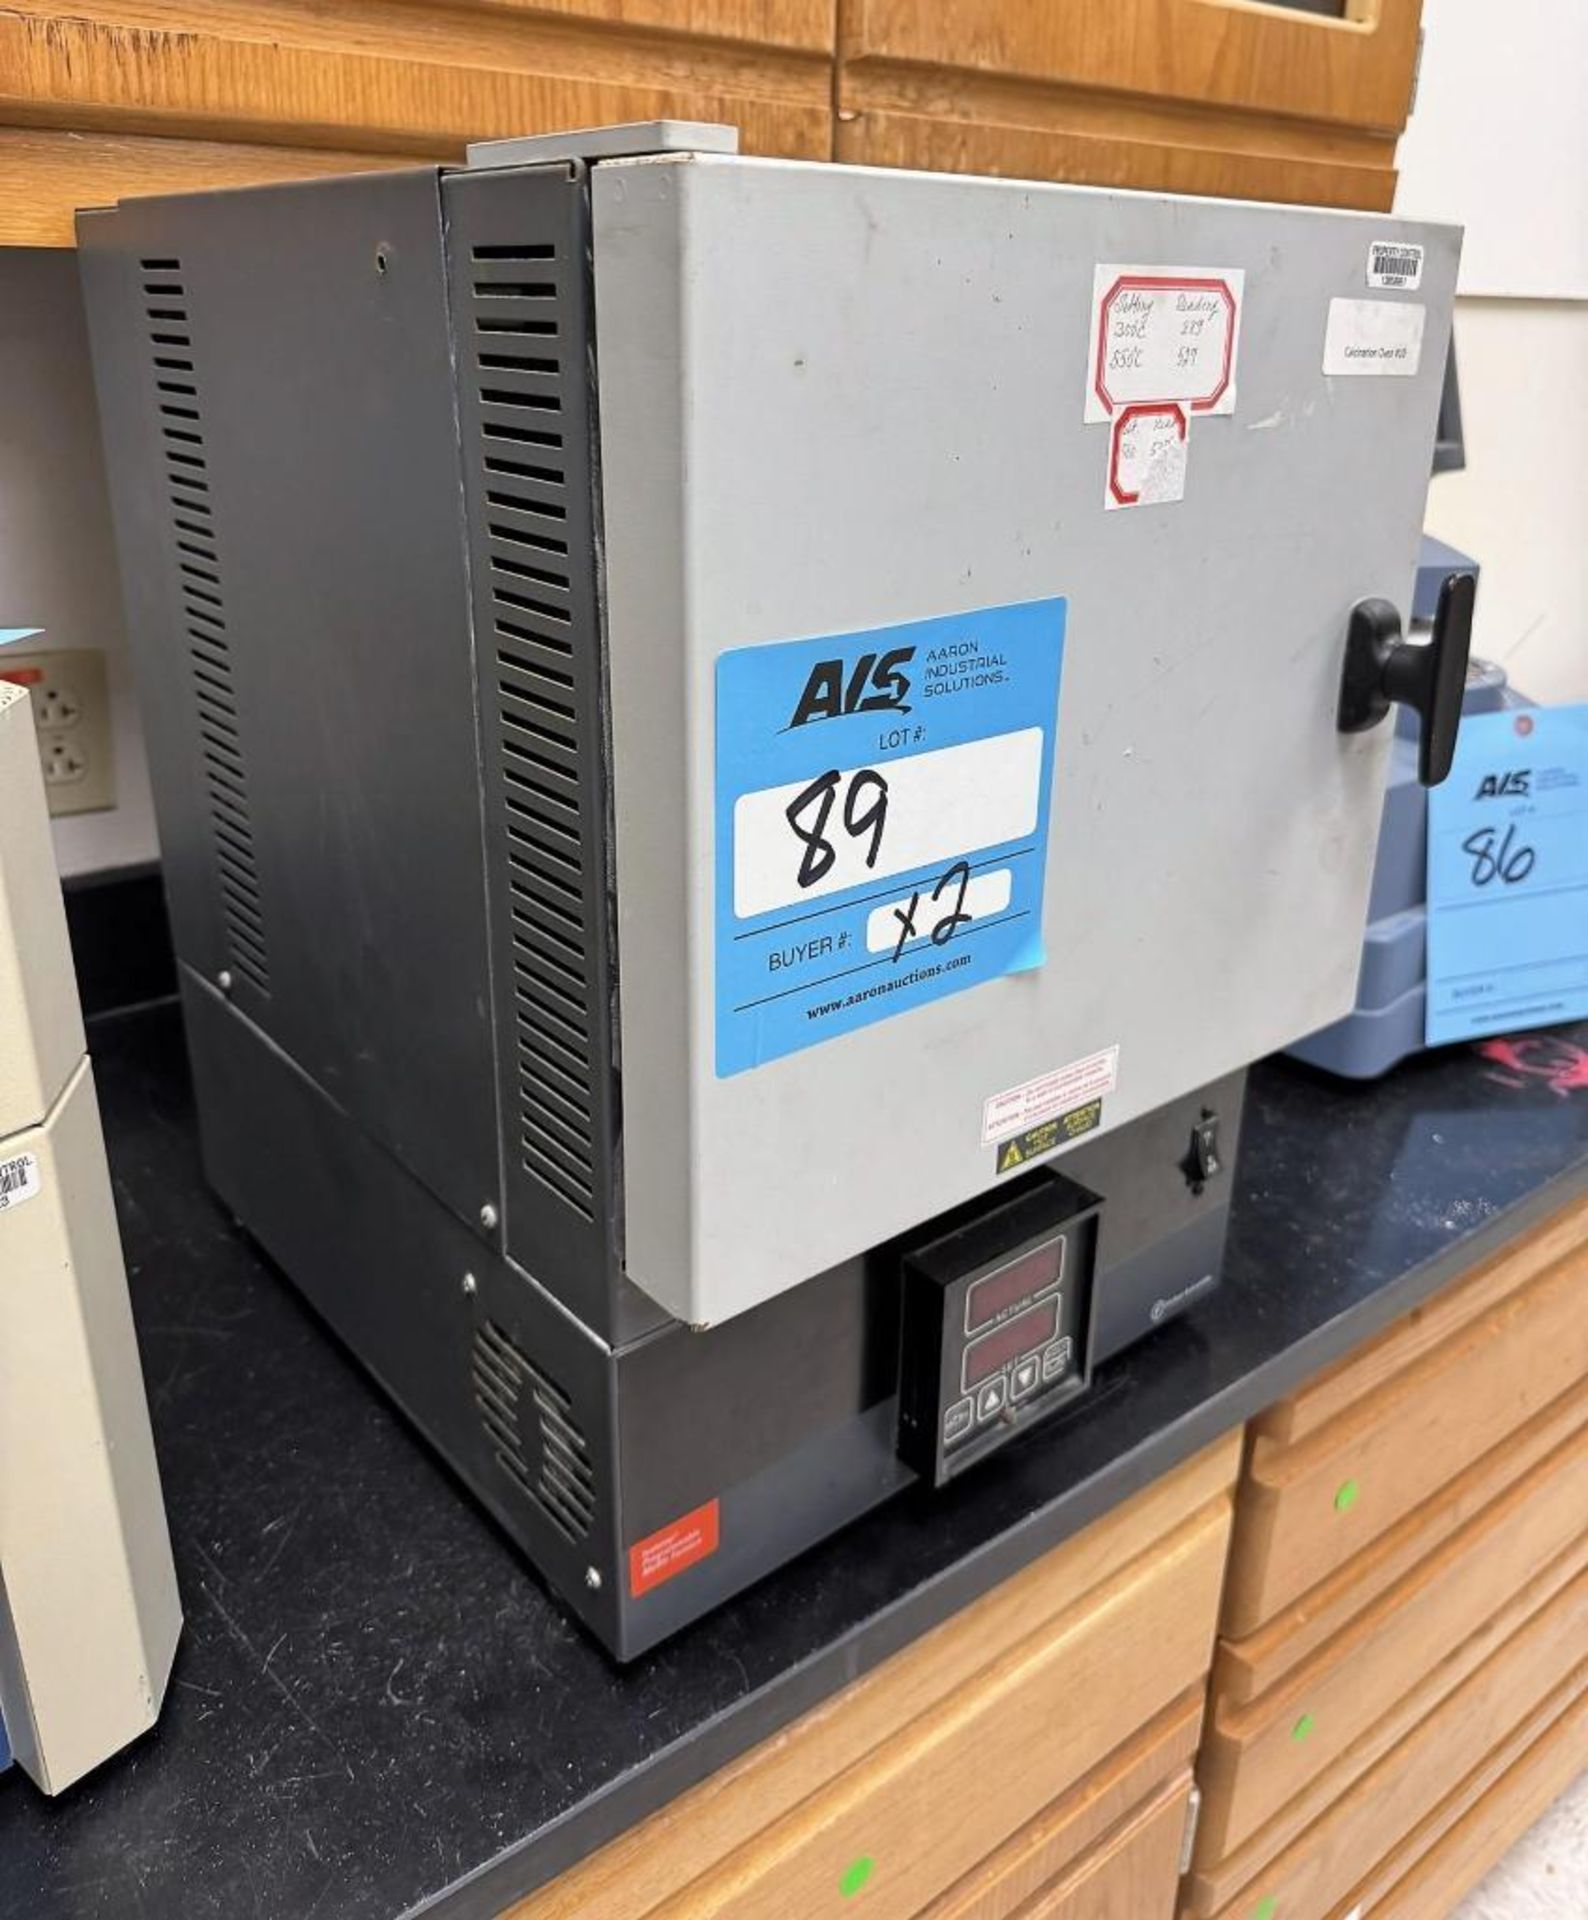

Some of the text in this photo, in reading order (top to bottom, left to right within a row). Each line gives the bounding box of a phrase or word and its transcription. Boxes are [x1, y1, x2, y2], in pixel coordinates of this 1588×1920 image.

[925, 653, 1007, 679] INDUSTRIAL
[926, 641, 979, 662] AARON
[782, 645, 917, 733] AIS
[879, 728, 911, 750] LOT
[1472, 769, 1532, 801] AIS
[785, 769, 888, 889] 89
[1462, 823, 1535, 888] 86
[768, 935, 833, 971] BUYER
[806, 953, 972, 1020] www.aaronauctions.com
